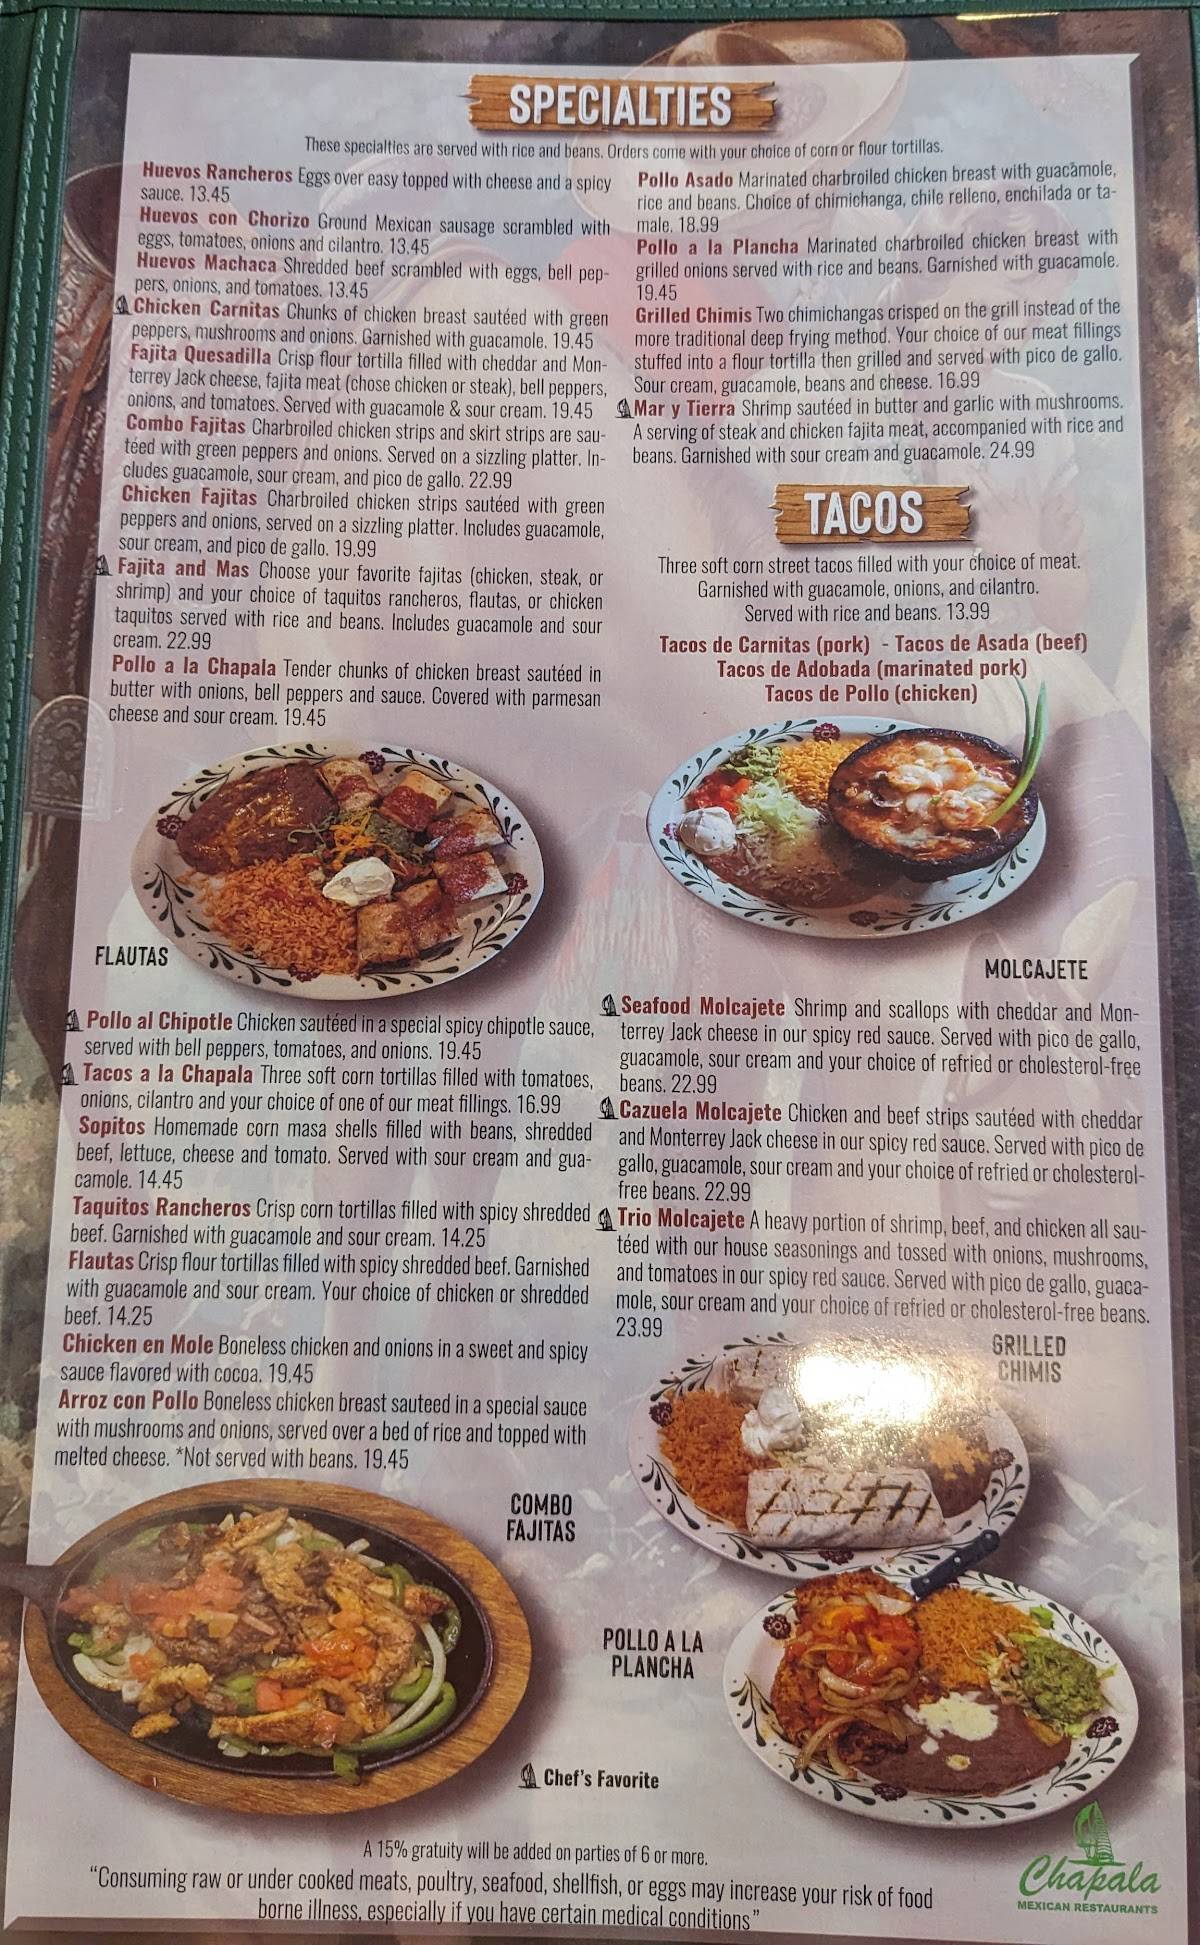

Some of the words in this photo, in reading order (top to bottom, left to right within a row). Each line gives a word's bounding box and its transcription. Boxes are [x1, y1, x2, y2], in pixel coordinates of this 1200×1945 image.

[509, 83, 732, 127] SPECIALTIES
[305, 136, 340, 152] These
[344, 139, 410, 156] specialties
[414, 144, 433, 156] are
[437, 141, 477, 157] served
[481, 142, 508, 157] with
[512, 144, 535, 158] rice
[539, 143, 560, 158] and
[565, 143, 603, 158] beans.
[608, 144, 648, 158] Orders
[653, 148, 686, 159] come
[690, 145, 716, 159] with
[720, 148, 747, 160] your
[751, 144, 790, 159] choice
[795, 143, 807, 158] of
[810, 145, 838, 157] corn
[842, 144, 855, 156] or
[859, 140, 887, 156] flour
[892, 139, 943, 154] tortillas.
[143, 162, 201, 178] Huevos
[206, 164, 293, 182] Rancheros
[298, 167, 330, 188] Eggs
[334, 172, 364, 185] over
[368, 174, 398, 189] easy
[403, 170, 448, 191] topped
[453, 172, 481, 189] with
[486, 173, 532, 190] cheese
[537, 173, 560, 190] and
[565, 178, 572, 190] a
[576, 175, 611, 195] spicy
[141, 188, 183, 201] sauce.
[190, 185, 230, 202] 13.45
[637, 238, 678, 255] Pollo
[688, 243, 697, 255] a
[708, 239, 722, 255] la
[733, 237, 798, 255] Plancha
[807, 235, 877, 253] Marinated
[885, 234, 964, 251] charbroiled
[972, 231, 1025, 249] chicken
[1035, 230, 1079, 247] breast
[1088, 229, 1118, 245] with
[637, 283, 677, 301] 19.45
[804, 490, 923, 535] TACOS
[745, 604, 793, 622] Served
[798, 604, 828, 622] with
[833, 605, 860, 622] rice
[865, 603, 890, 621] and
[895, 603, 941, 621] beans.
[947, 602, 990, 620] 13.99
[113, 635, 161, 649] cream.
[167, 631, 211, 650] 22.99
[659, 635, 707, 653] Tacos
[713, 636, 732, 653] de
[739, 636, 810, 653] Carnitas
[817, 635, 869, 656] (pork)
[895, 635, 944, 652] Tacos
[950, 634, 970, 651] de
[977, 633, 1028, 651] Asada
[1036, 633, 1087, 654] (beef)
[717, 660, 765, 678] Tacos
[771, 660, 790, 678] de
[796, 659, 870, 677] Adobada
[877, 659, 973, 681] (marinated
[980, 658, 1027, 679] pork)
[765, 684, 813, 702] Tacos
[819, 684, 839, 702] de
[846, 684, 889, 702] Pollo
[895, 683, 977, 705] (chicken)
[109, 704, 158, 722] cheese
[163, 705, 189, 723] and
[193, 710, 226, 724] sour
[229, 711, 278, 725] cream.
[284, 708, 326, 726] 19.45
[95, 945, 168, 967] FLAUTAS
[985, 958, 1088, 980] MOLCAJETE
[621, 995, 690, 1015] Seafood
[700, 997, 785, 1019] Molcajete
[794, 998, 847, 1021] Shrimp
[855, 999, 881, 1018] and
[889, 1000, 949, 1022] scallops
[957, 1000, 989, 1020] with
[997, 1001, 1058, 1021] cheddar
[1065, 1002, 1092, 1021] and
[1101, 1003, 1139, 1022] Mon-
[620, 1073, 666, 1093] beans.
[671, 1074, 717, 1094] 22.99
[75, 1169, 132, 1189] camole.
[139, 1169, 183, 1189] 14.45
[73, 1196, 149, 1220] Taquitos
[156, 1197, 251, 1217] Rancheros
[256, 1198, 295, 1222] Crisp
[301, 1203, 333, 1218] corn
[338, 1199, 396, 1219] tortillas
[401, 1200, 437, 1220] filled
[443, 1200, 474, 1221] with
[479, 1202, 518, 1225] spicy
[523, 1201, 590, 1222] shredded
[616, 1317, 663, 1338] 23.99
[63, 1333, 137, 1353] Chicken
[143, 1339, 164, 1354] en
[171, 1334, 213, 1354] Mole
[219, 1334, 286, 1355] Boneless
[291, 1336, 348, 1356] chicken
[353, 1336, 380, 1357] and
[385, 1338, 433, 1357] onions
[438, 1338, 451, 1358] in
[456, 1343, 464, 1358] a
[469, 1339, 513, 1359] sweet
[518, 1339, 544, 1360] and
[549, 1341, 588, 1365] spicy
[992, 1334, 1066, 1357] GRILLED
[999, 1360, 1061, 1383] CHIMIS
[511, 1493, 572, 1516] COMBO
[507, 1519, 575, 1542] FAJITAS
[603, 1627, 658, 1652] POLLO
[664, 1630, 675, 1652] A
[681, 1630, 704, 1652] LA
[612, 1654, 694, 1679] PLANCHA
[543, 1768, 592, 1789] Chef's
[597, 1770, 659, 1789] Favorite
[363, 1839, 372, 1858] A
[378, 1840, 408, 1858] 15%
[411, 1841, 463, 1862] gratuity
[467, 1841, 489, 1859] will
[494, 1841, 509, 1860] be
[513, 1842, 551, 1860] added
[556, 1847, 571, 1861] on
[575, 1844, 620, 1865] parties
[624, 1845, 637, 1863] of
[641, 1845, 650, 1863] 6
[654, 1850, 667, 1864] or
[671, 1851, 708, 1866] more.
[192, 1872, 222, 1889] raw
[227, 1873, 243, 1889] or
[248, 1867, 294, 1890] under
[298, 1867, 354, 1890] cooked
[359, 1870, 411, 1892] meats,
[417, 1870, 476, 1896] poultry,
[482, 1871, 547, 1894] seafood,
[553, 1872, 622, 1897] shellfish,
[627, 1880, 644, 1896] or
[649, 1881, 686, 1902] eggs
[692, 1882, 725, 1903] may
[730, 1880, 796, 1902] increase
[802, 1887, 837, 1907] your
[843, 1884, 873, 1906] risk
[877, 1886, 894, 1908] of
[898, 1887, 933, 1909] food
[1019, 1855, 1161, 1901] Chapala
[1017, 1900, 1070, 1912] MEXICAN
[1074, 1903, 1158, 1914] RESTAURANTS
